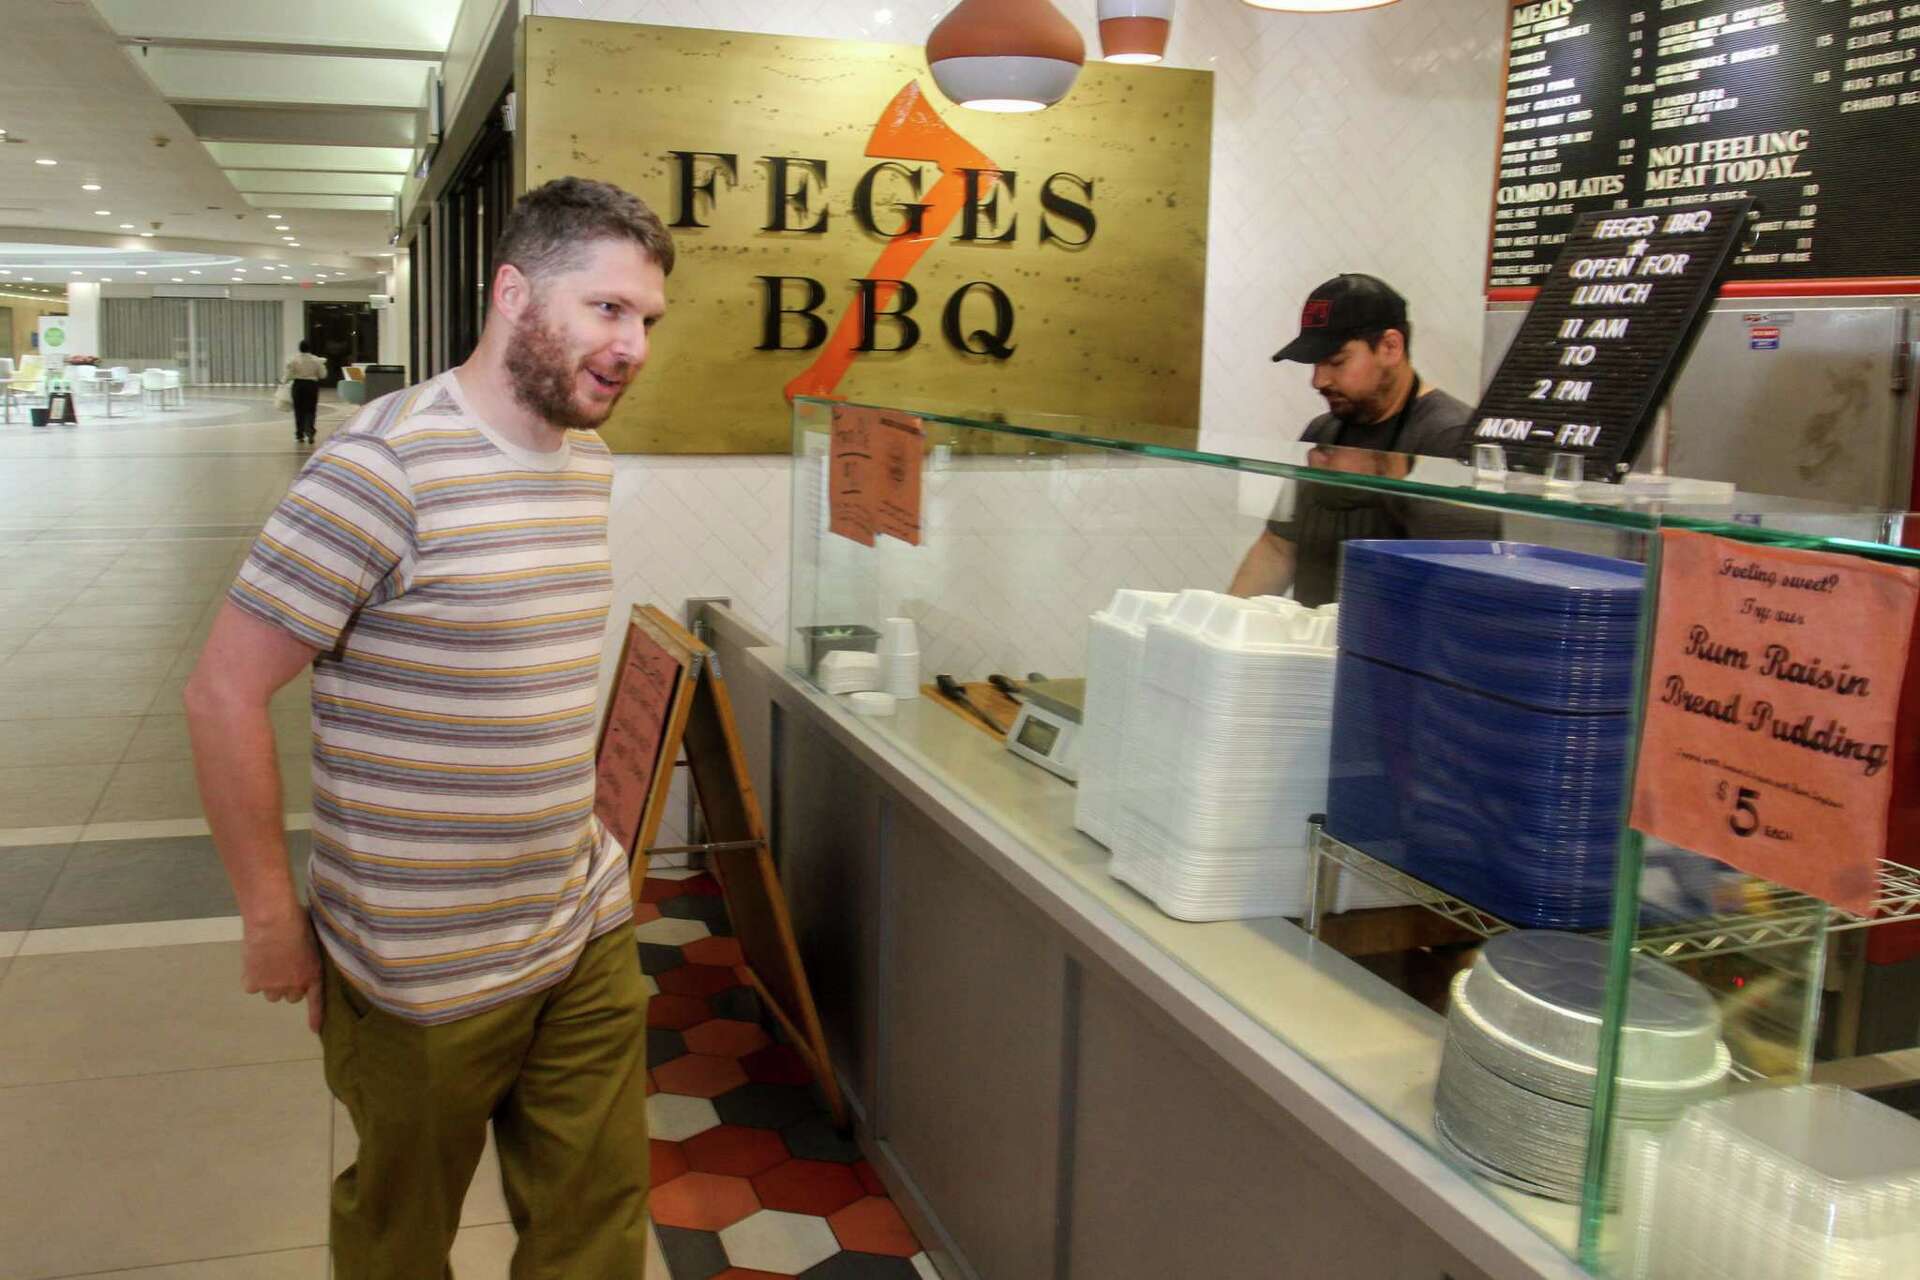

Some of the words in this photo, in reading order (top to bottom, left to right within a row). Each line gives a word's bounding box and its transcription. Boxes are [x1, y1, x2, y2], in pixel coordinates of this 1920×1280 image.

[1513, 0, 1573, 27] MEATS
[1648, 142, 1700, 168] NOT
[1701, 129, 1810, 163] FEELING
[1497, 182, 1557, 205] COMBO
[1558, 174, 1626, 200] PLATES
[1645, 165, 1712, 191] MEAT
[668, 149, 1098, 247] FEGES
[1593, 215, 1659, 239] FEGES
[1664, 210, 1712, 234] BBQ
[1569, 256, 1637, 280] OPEN
[1638, 253, 1690, 276] FOR
[1572, 283, 1653, 305] LUNCH
[754, 275, 1018, 359] BBQ
[1559, 319, 1583, 339] 11
[1585, 318, 1630, 339] AM
[1560, 345, 1596, 367] TO
[1530, 379, 1553, 400] 2
[1554, 380, 1593, 401] PM
[1718, 558, 1777, 588] Feeling
[1781, 574, 1840, 593] sweet?
[1740, 598, 1772, 623] Try
[1775, 610, 1804, 624] our
[1684, 624, 1749, 671] Rum
[1759, 644, 1870, 698] Raisin
[1661, 674, 1742, 726] Bread
[1746, 701, 1888, 777] Pudding
